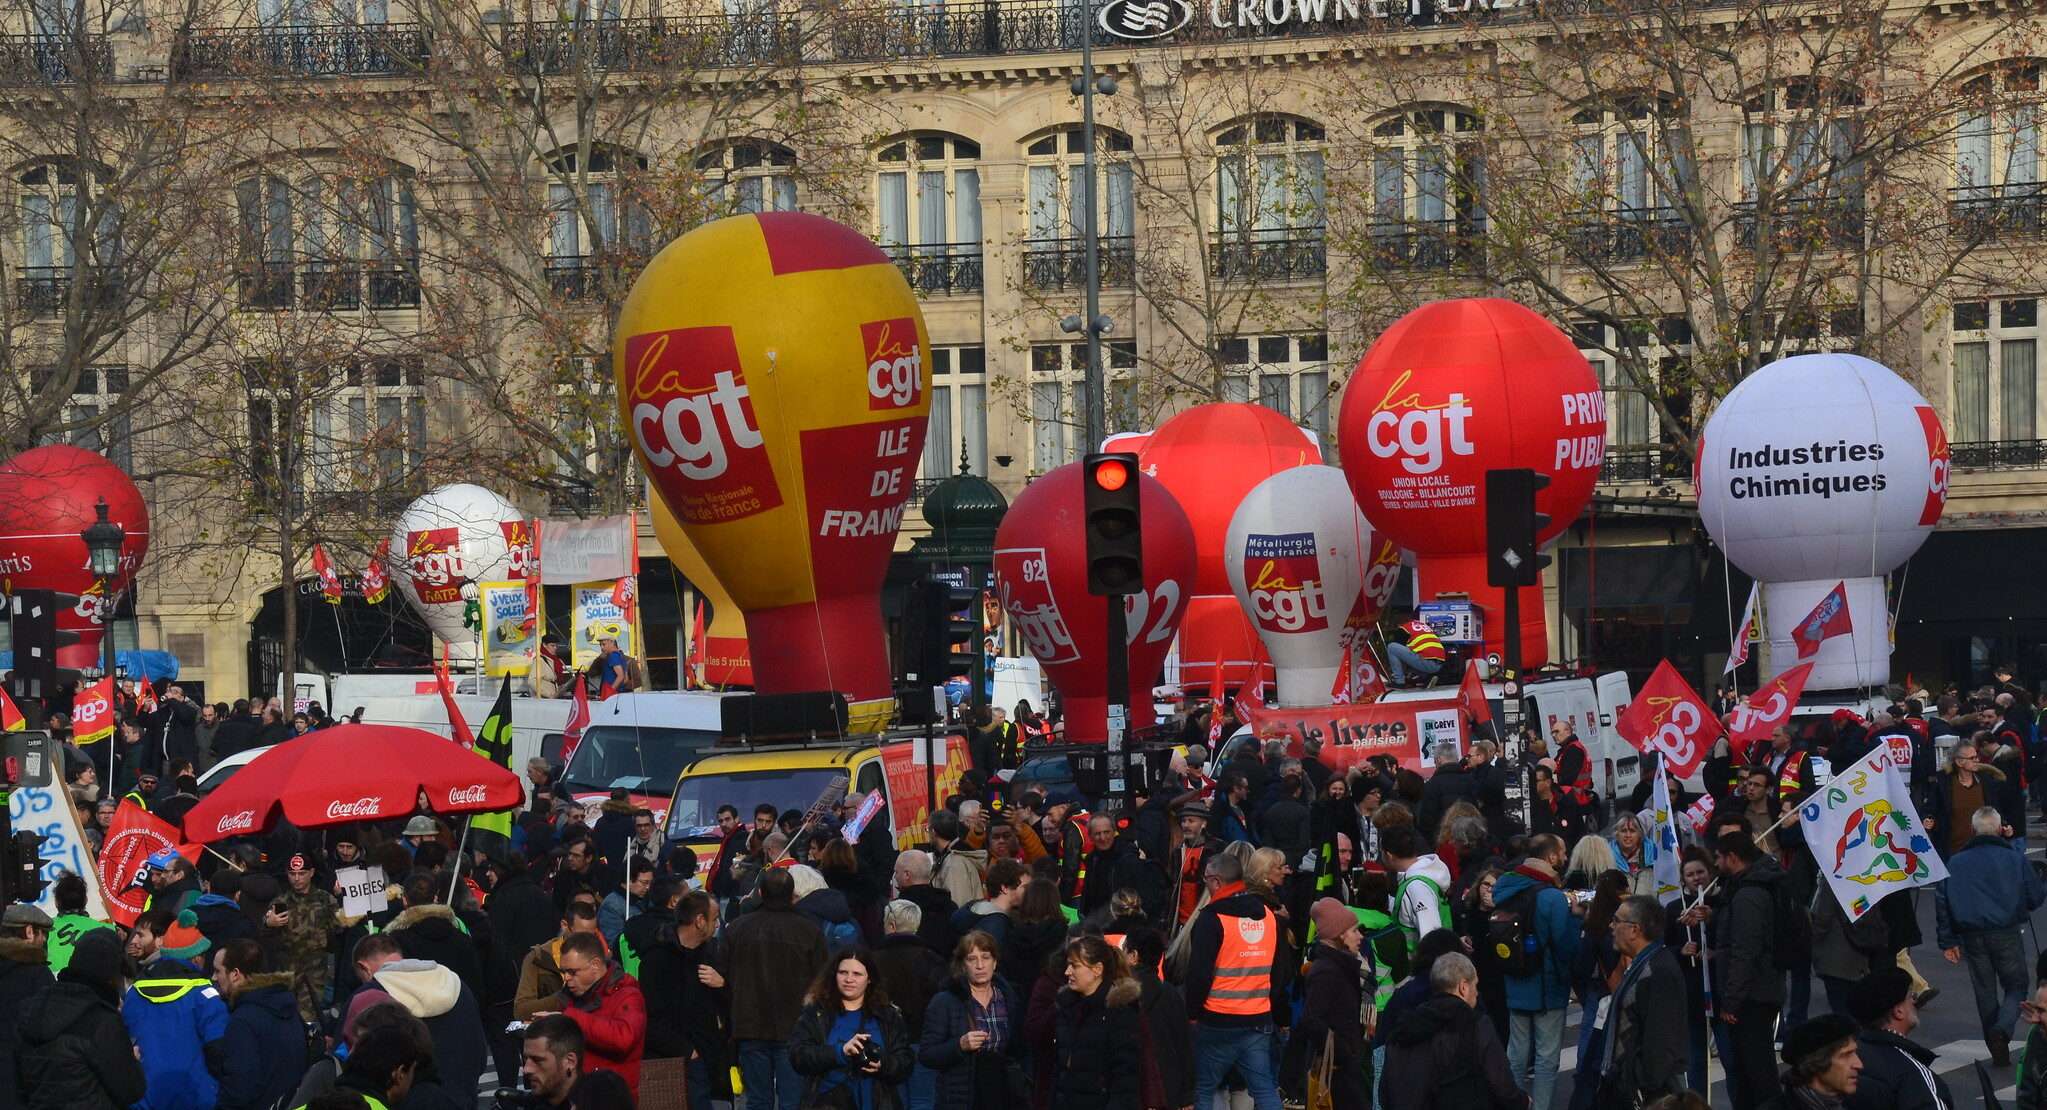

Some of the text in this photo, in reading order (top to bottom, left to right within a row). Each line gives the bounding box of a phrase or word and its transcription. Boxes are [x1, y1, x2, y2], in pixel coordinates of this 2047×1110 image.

[868, 322, 913, 359] la
[630, 335, 724, 400] la
[867, 345, 921, 405] cgt
[1372, 369, 1438, 415] la
[1562, 391, 1606, 426] PRIV
[632, 370, 763, 481] cgt
[1367, 393, 1474, 474] cgt
[877, 426, 911, 458] ILE
[1555, 434, 1606, 470] PUBLI
[1729, 440, 1884, 470] Industries
[870, 467, 904, 497] DE
[1392, 475, 1450, 488] UNION LOCALE
[1419, 486, 1475, 499] BILLANCOURT
[1729, 470, 1887, 499] Chimiques
[820, 503, 905, 537] FRANC
[1249, 538, 1313, 549] Métallurgie
[1262, 549, 1275, 557] de
[1277, 547, 1316, 557] france
[0, 552, 32, 574] aris
[408, 545, 464, 586] cgt
[1023, 559, 1046, 582] 92
[1250, 580, 1328, 631] cgt
[729, 656, 751, 667] min
[1328, 718, 1408, 746] livre
[1353, 733, 1407, 750] parisien
[327, 797, 382, 818] Coca-Cola
[449, 784, 487, 805] Coca-Cola
[217, 810, 256, 833] Coca-Cola
